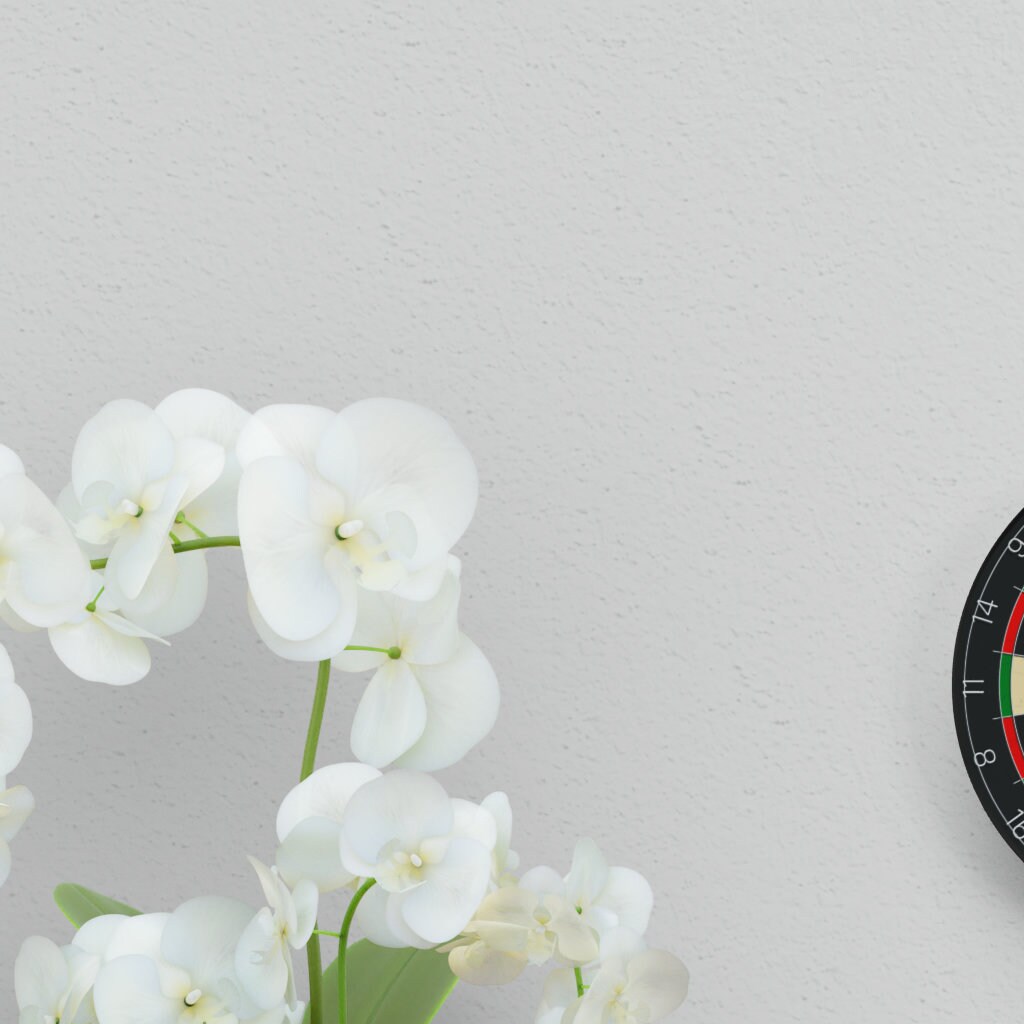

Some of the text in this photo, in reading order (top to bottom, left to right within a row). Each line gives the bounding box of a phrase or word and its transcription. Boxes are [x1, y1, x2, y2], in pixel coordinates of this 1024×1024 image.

[972, 599, 998, 624] 14
[962, 679, 984, 697] 11
[973, 749, 996, 767] 8
